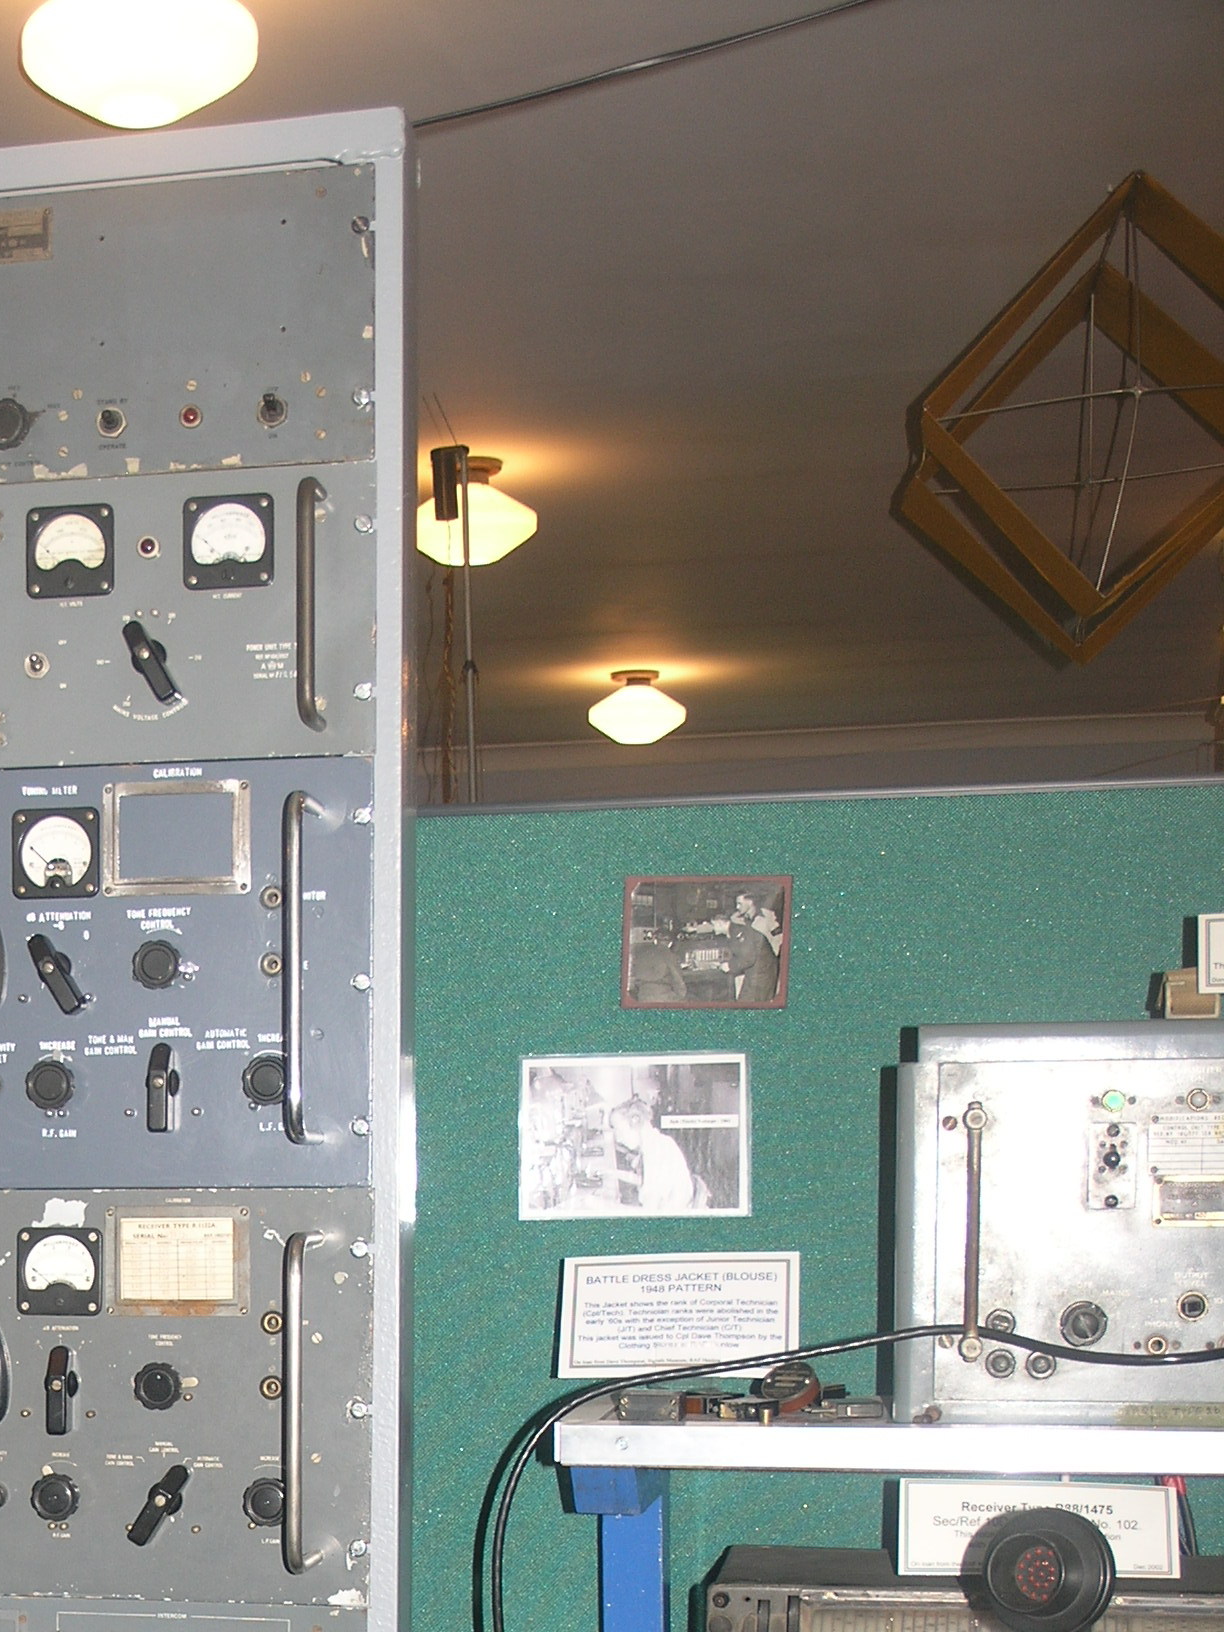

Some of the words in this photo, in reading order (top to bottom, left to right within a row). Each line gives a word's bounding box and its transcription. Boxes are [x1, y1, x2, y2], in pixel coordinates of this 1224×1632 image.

[153, 767, 202, 779] CALIBRATION
[39, 910, 92, 923] ATTENUATION
[127, 908, 146, 919] TONE
[148, 906, 191, 917] FREQUENCY
[140, 918, 175, 930] CONTROL
[148, 1017, 180, 1028] MANUAL
[138, 1028, 157, 1039] GAIN
[159, 1025, 192, 1039] CONTROL
[204, 1028, 247, 1039] AUTOMATIC
[88, 1035, 108, 1045] TONE
[217, 1038, 250, 1050] CONTROL
[39, 1041, 76, 1052] INCREASE
[104, 1044, 137, 1056] CONTROL
[586, 1275, 629, 1285] BATTLE
[632, 1273, 672, 1283] DRESS
[675, 1272, 719, 1282] JACKET
[722, 1271, 778, 1282] (BLOUSE)
[641, 1285, 665, 1294] 1948
[668, 1283, 722, 1293] PATTERN
[602, 1301, 627, 1309] Jacket
[630, 1300, 654, 1308] shows
[699, 1298, 733, 1308] Corporal
[629, 1308, 669, 1316] Technician
[716, 1307, 754, 1315] abolished
[766, 1307, 778, 1315] the
[585, 1318, 604, 1326] early
[656, 1316, 694, 1324] exception
[732, 1315, 775, 1323] Technician
[595, 1334, 619, 1342] jacket
[638, 1333, 664, 1341] issued
[715, 1332, 756, 1341] Thompson
[758, 1333, 767, 1341] by
[618, 1342, 651, 1350] Clothing
[961, 1501, 1017, 1513] Receiver
[932, 1515, 982, 1528] Sec/Ref
